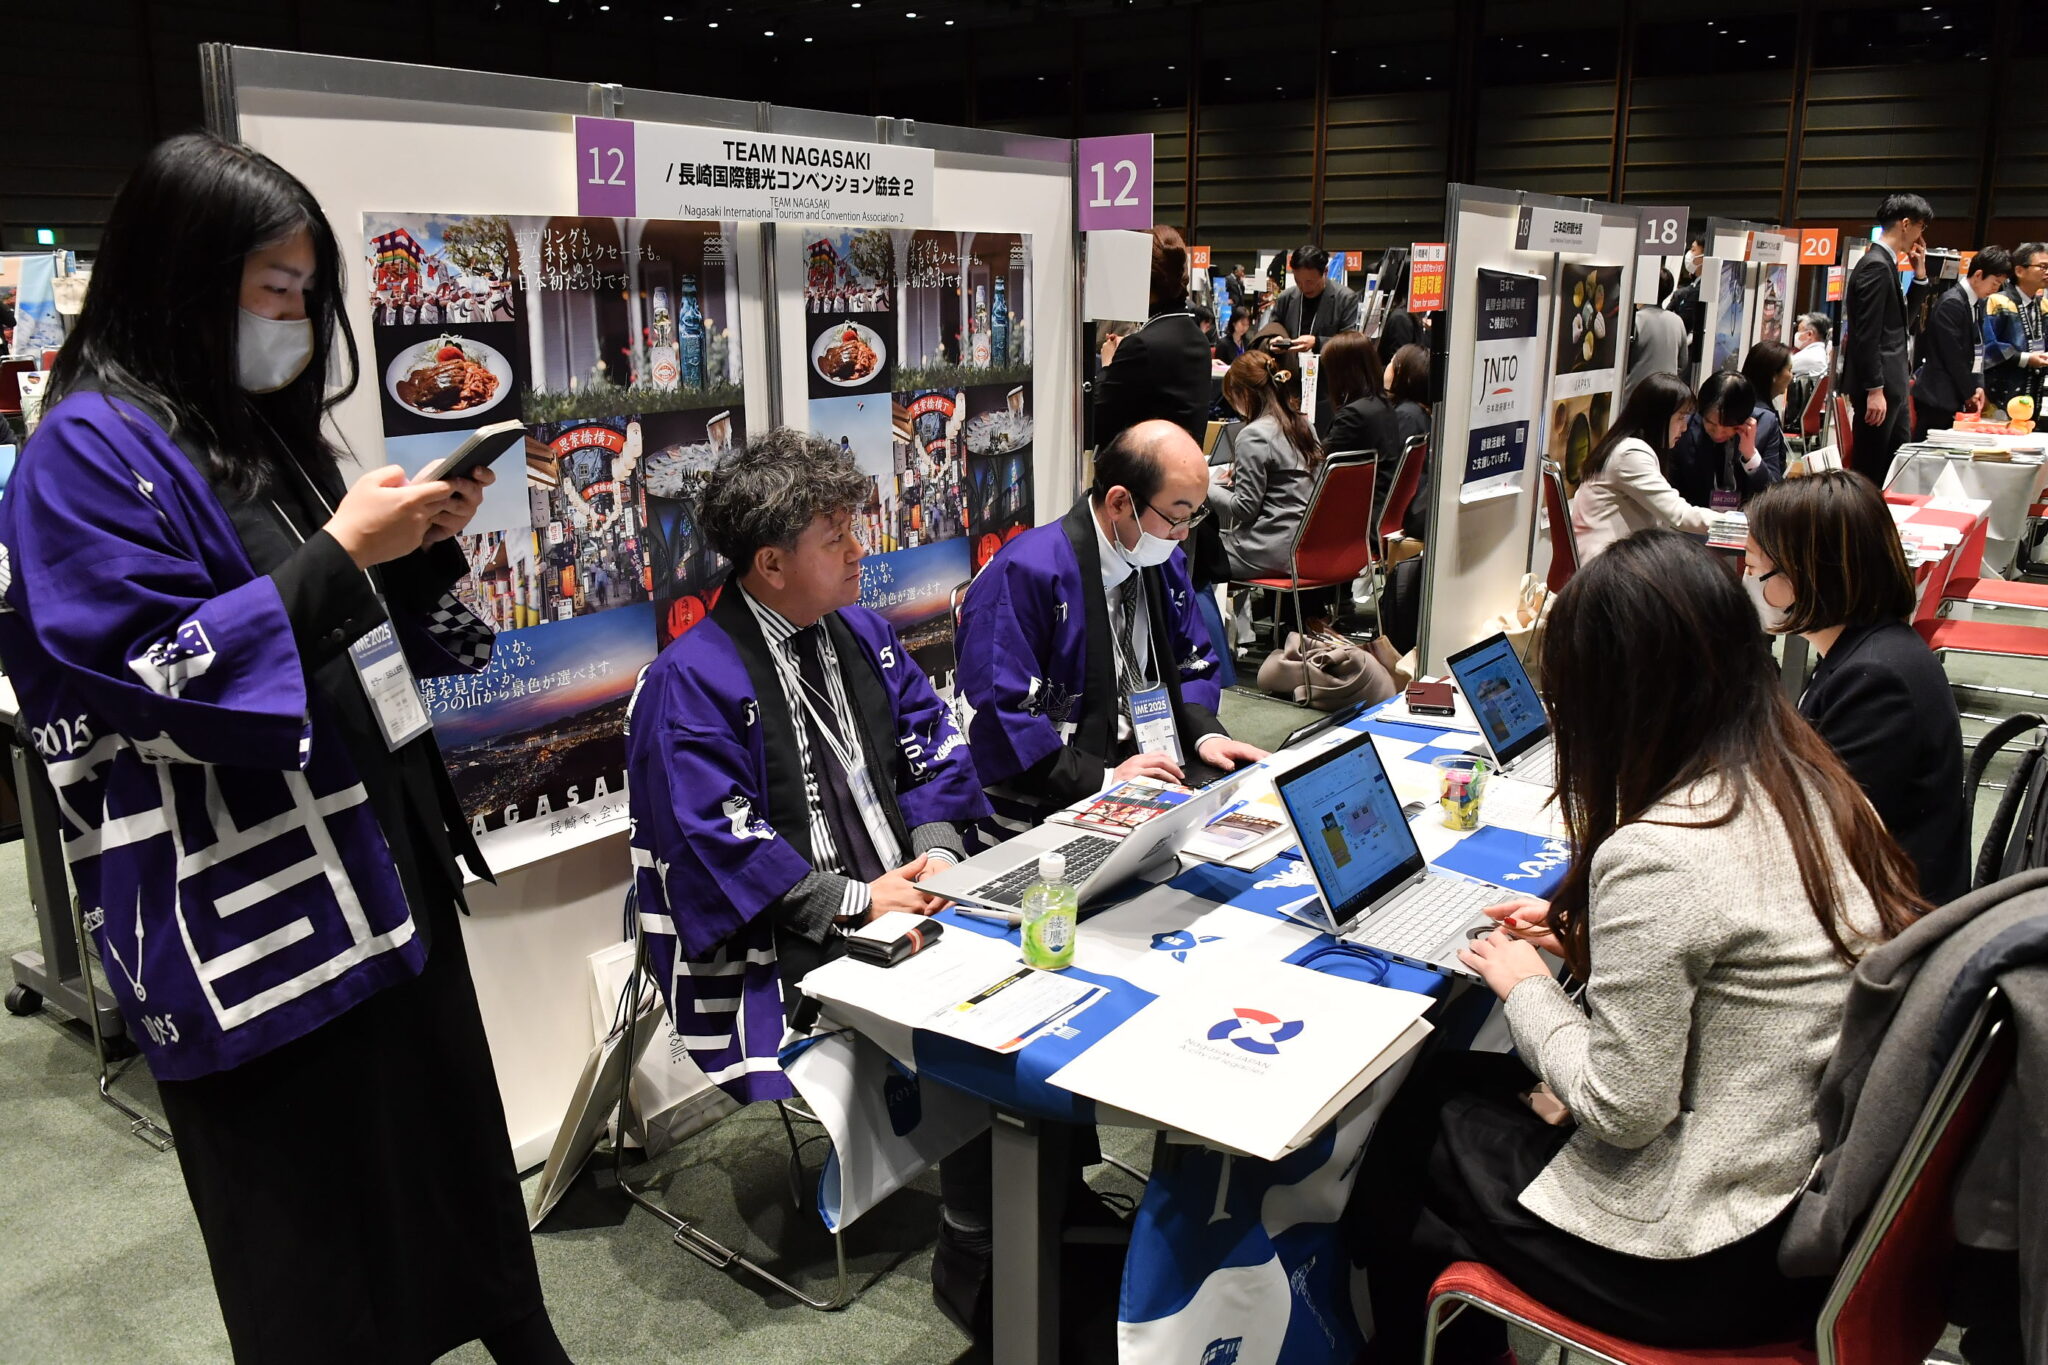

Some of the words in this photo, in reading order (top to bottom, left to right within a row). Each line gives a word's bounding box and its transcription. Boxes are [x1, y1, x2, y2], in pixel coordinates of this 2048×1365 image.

[723, 140, 776, 164] TEAM
[782, 147, 871, 171] NAGASAKI
[588, 146, 627, 186] 12
[1089, 159, 1140, 208] 12
[684, 203, 722, 220] Nagasaki
[724, 205, 773, 219] International
[774, 207, 805, 220] Tourism
[806, 208, 820, 221] and
[821, 208, 861, 222] Convention
[862, 210, 899, 222] Association
[900, 211, 905, 223] 2
[770, 196, 792, 208] TEAM
[793, 198, 830, 210] NAGASAKI
[1519, 217, 1530, 236] 18
[1644, 218, 1679, 245] 18
[1803, 237, 1831, 257] 20
[1194, 252, 1207, 264] 28
[1346, 256, 1359, 267] 31
[1478, 354, 1519, 406] JNTO
[1574, 377, 1592, 392] JAPAN
